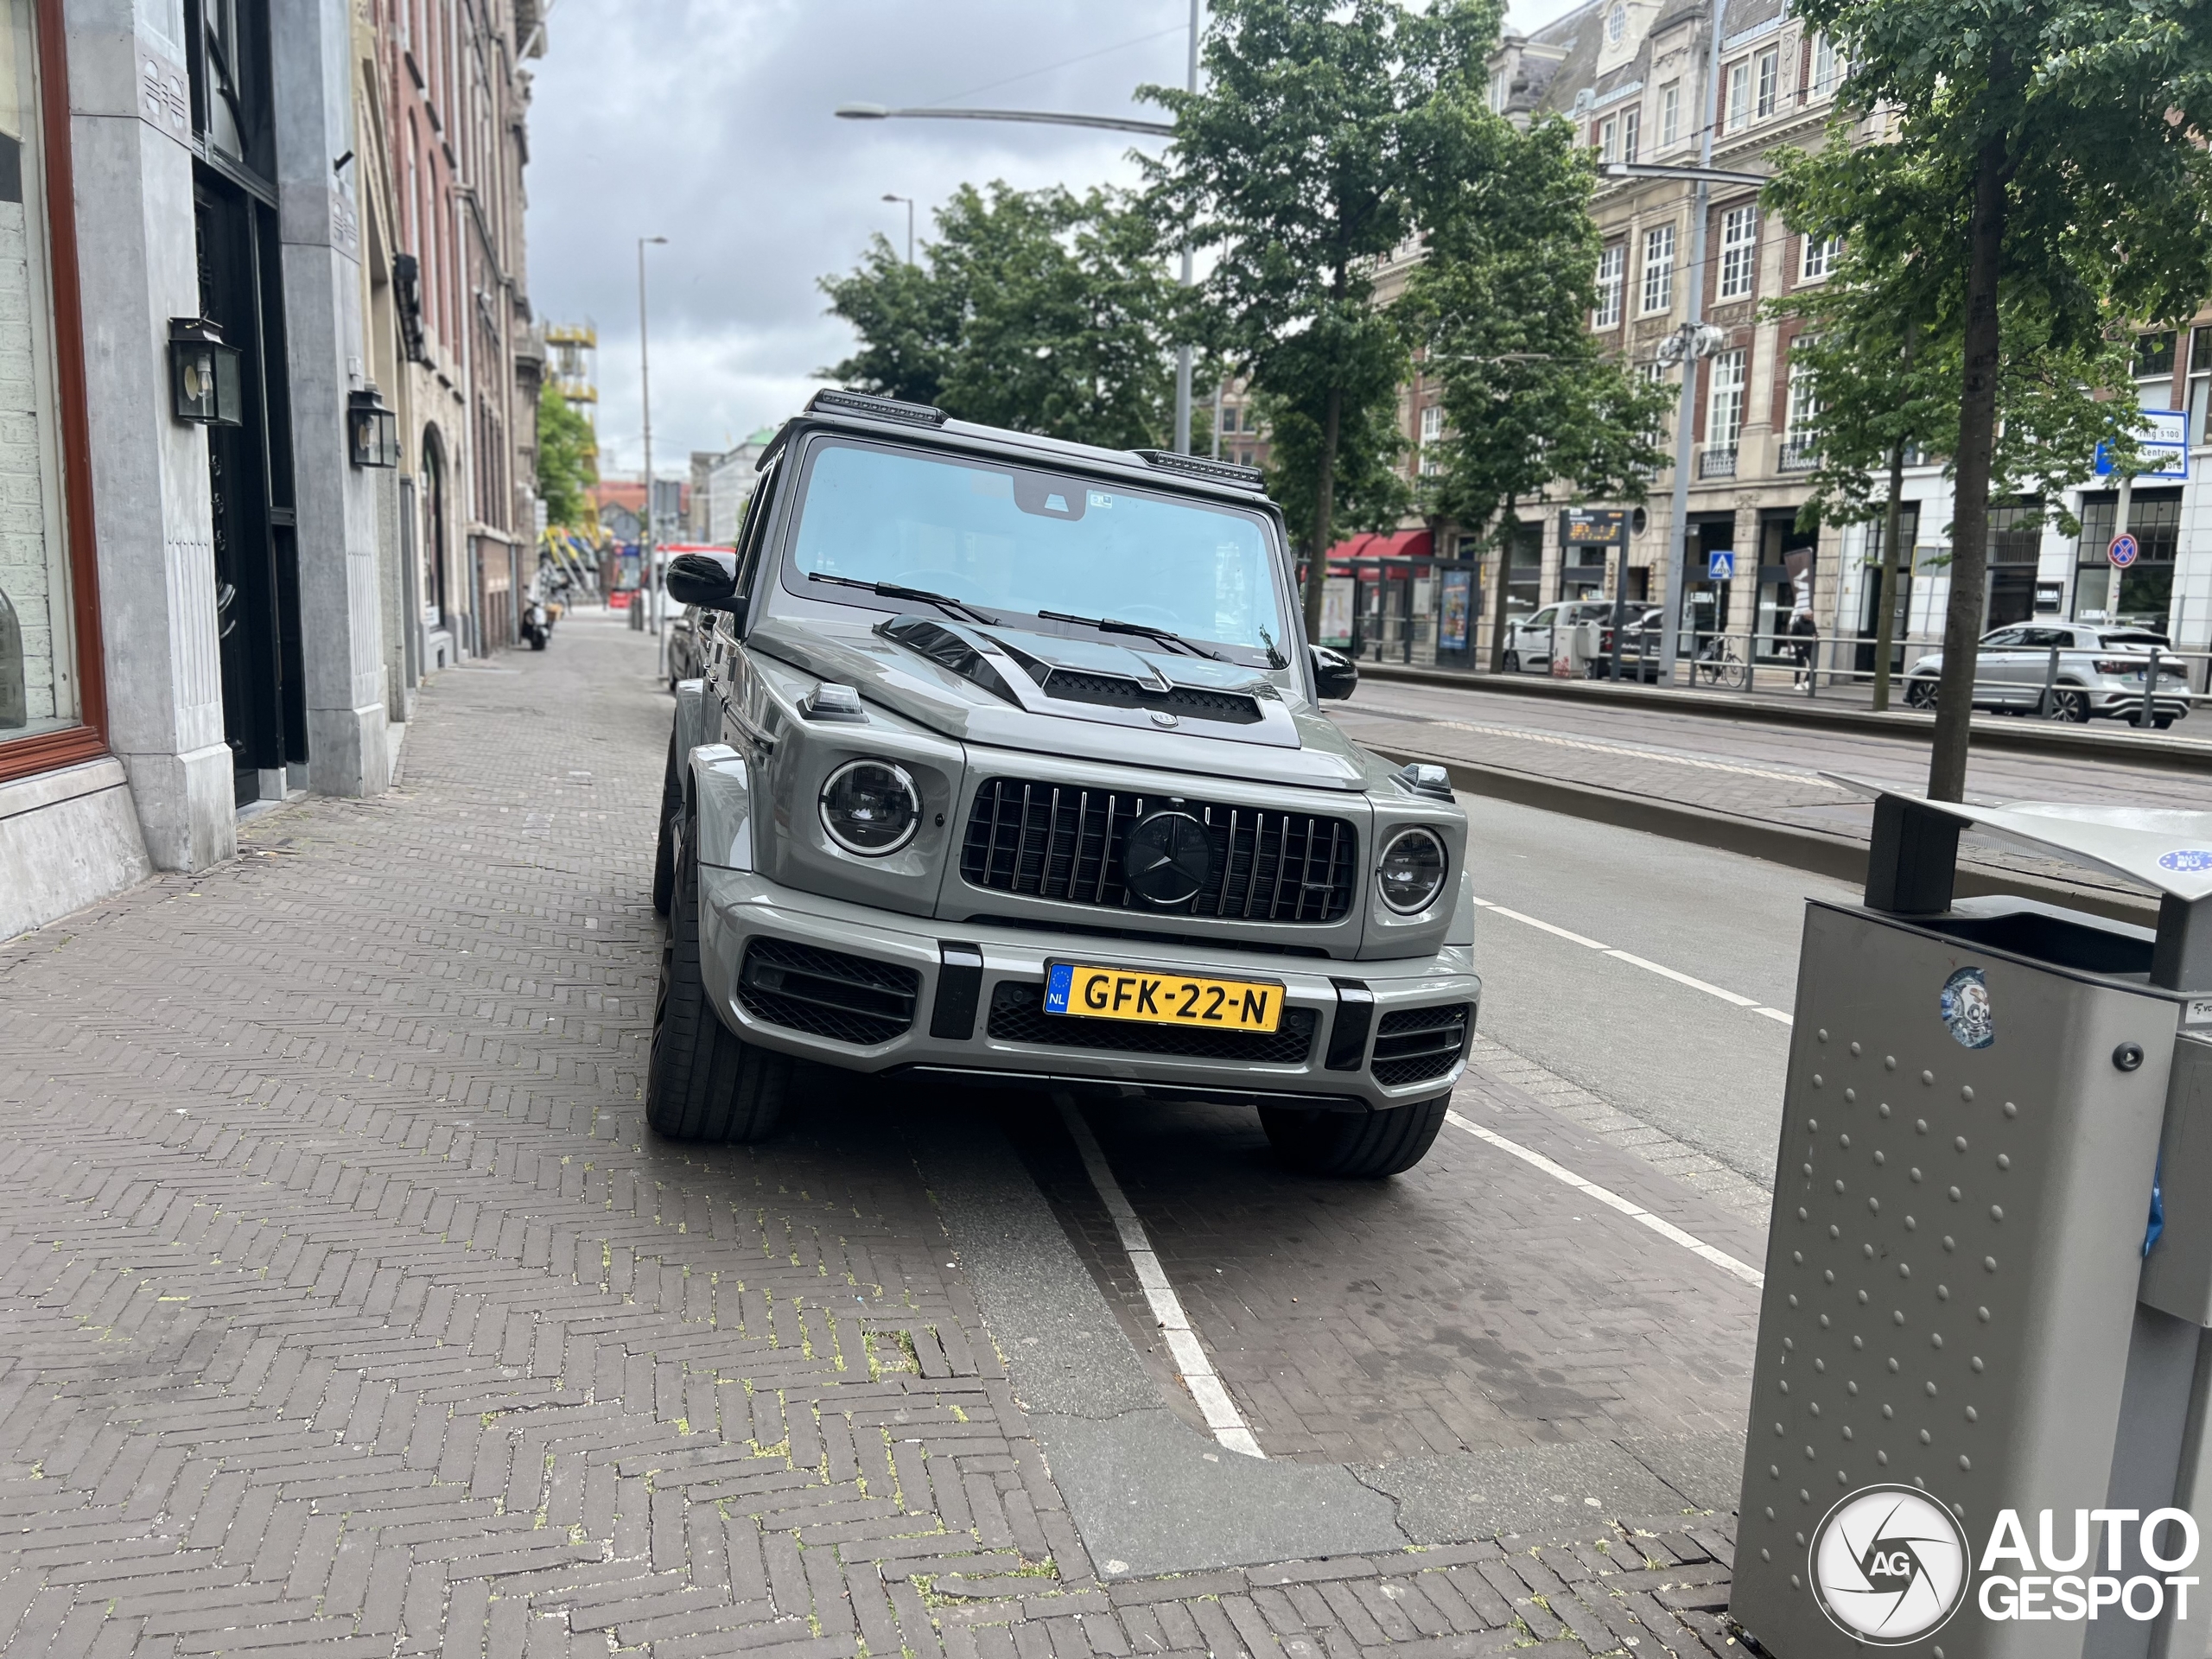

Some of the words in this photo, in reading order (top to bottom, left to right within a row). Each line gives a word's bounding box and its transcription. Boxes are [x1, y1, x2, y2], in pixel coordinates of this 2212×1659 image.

[2141, 447, 2178, 457] Centrum
[1049, 993, 1065, 1005] NL
[1084, 974, 1268, 1025] GFK-22-N
